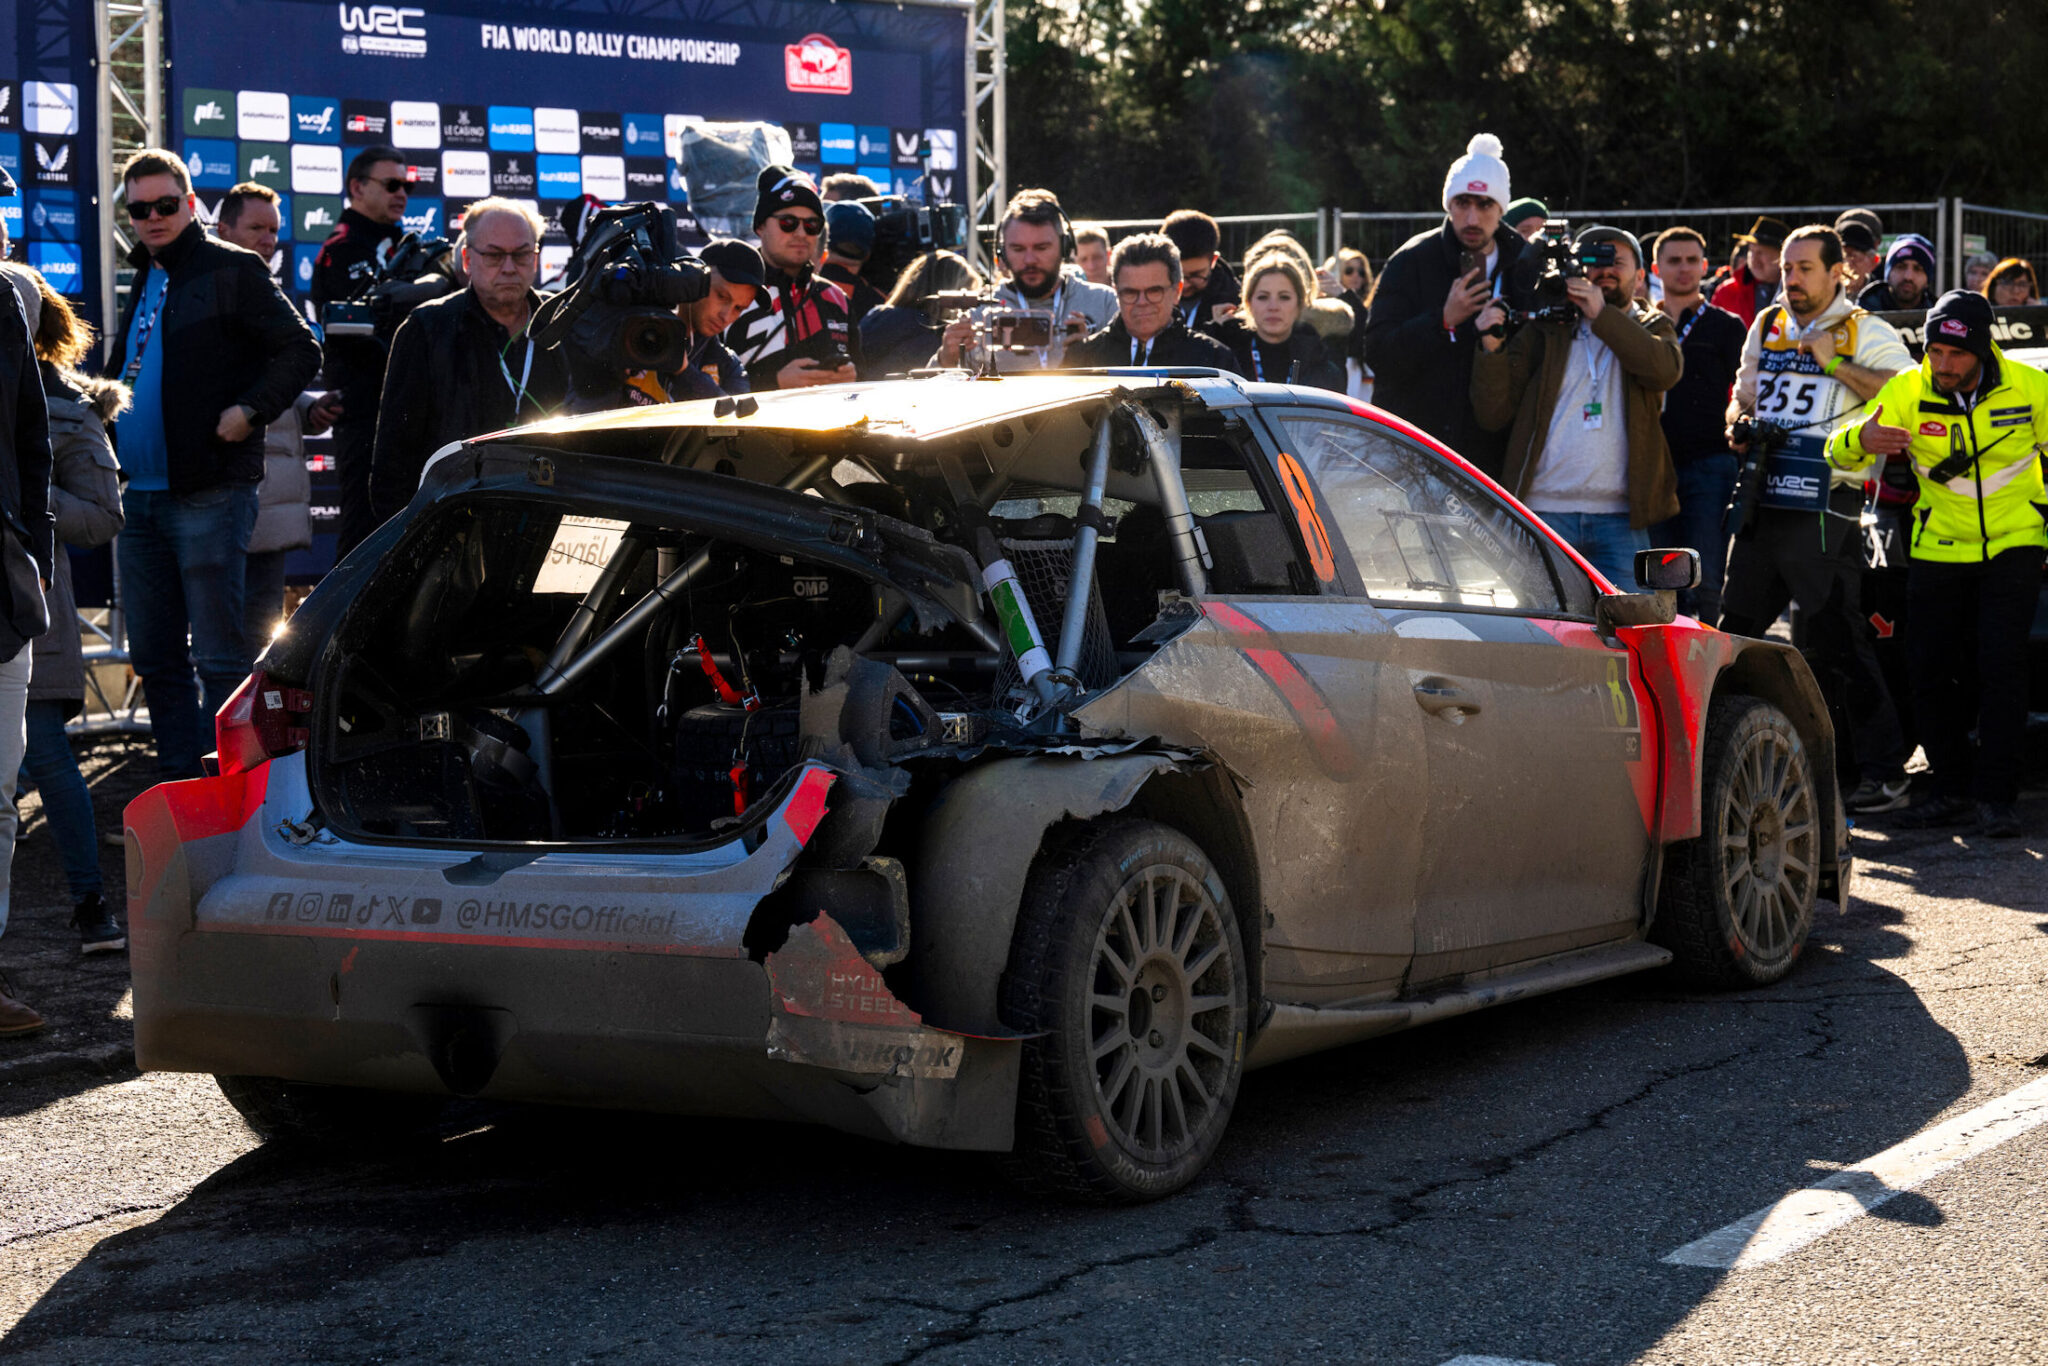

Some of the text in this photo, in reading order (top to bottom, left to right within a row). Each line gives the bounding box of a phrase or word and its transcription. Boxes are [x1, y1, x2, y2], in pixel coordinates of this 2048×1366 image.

[339, 2, 426, 37] WRC
[481, 24, 741, 66] FIA WORLD RALLY CHAMPIONSHIP
[1757, 379, 1817, 416] 255
[1767, 474, 1820, 491] WRC
[1277, 452, 1335, 583] 8
[793, 580, 829, 597] OMP
[1606, 657, 1628, 727] 8
[456, 898, 678, 934] @HMSGOfficial
[829, 992, 901, 1014] STEEL
